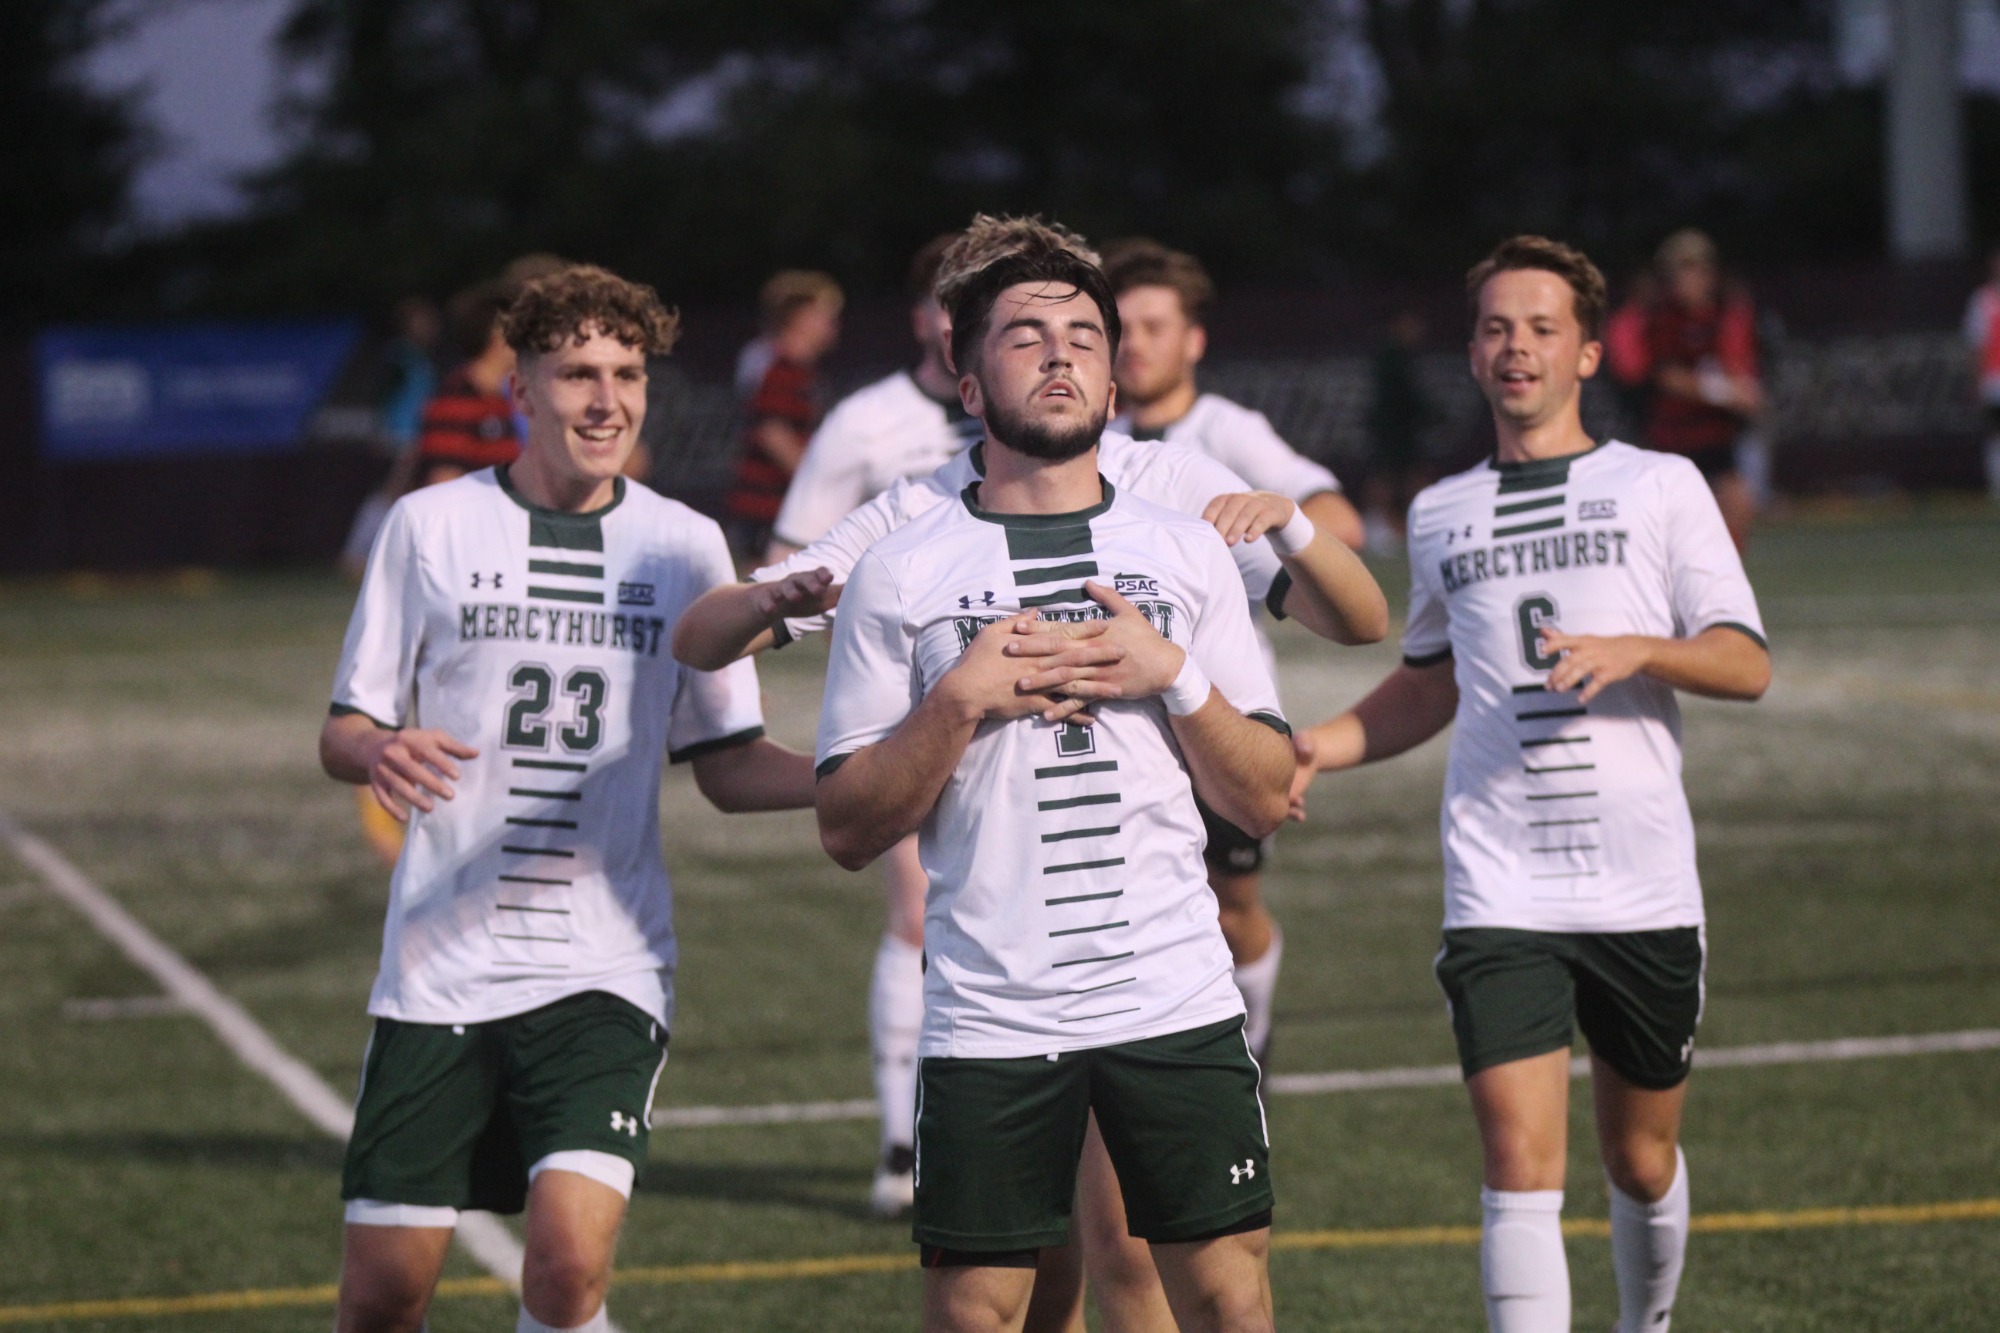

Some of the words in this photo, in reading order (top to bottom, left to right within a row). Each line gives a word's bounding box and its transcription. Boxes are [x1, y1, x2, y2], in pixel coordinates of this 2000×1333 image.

[1114, 580, 1159, 592] PSAC
[1440, 530, 1628, 594] MERCYHURST
[460, 602, 665, 656] MERCYHURST
[1512, 590, 1567, 675] 6
[500, 660, 610, 756] 23
